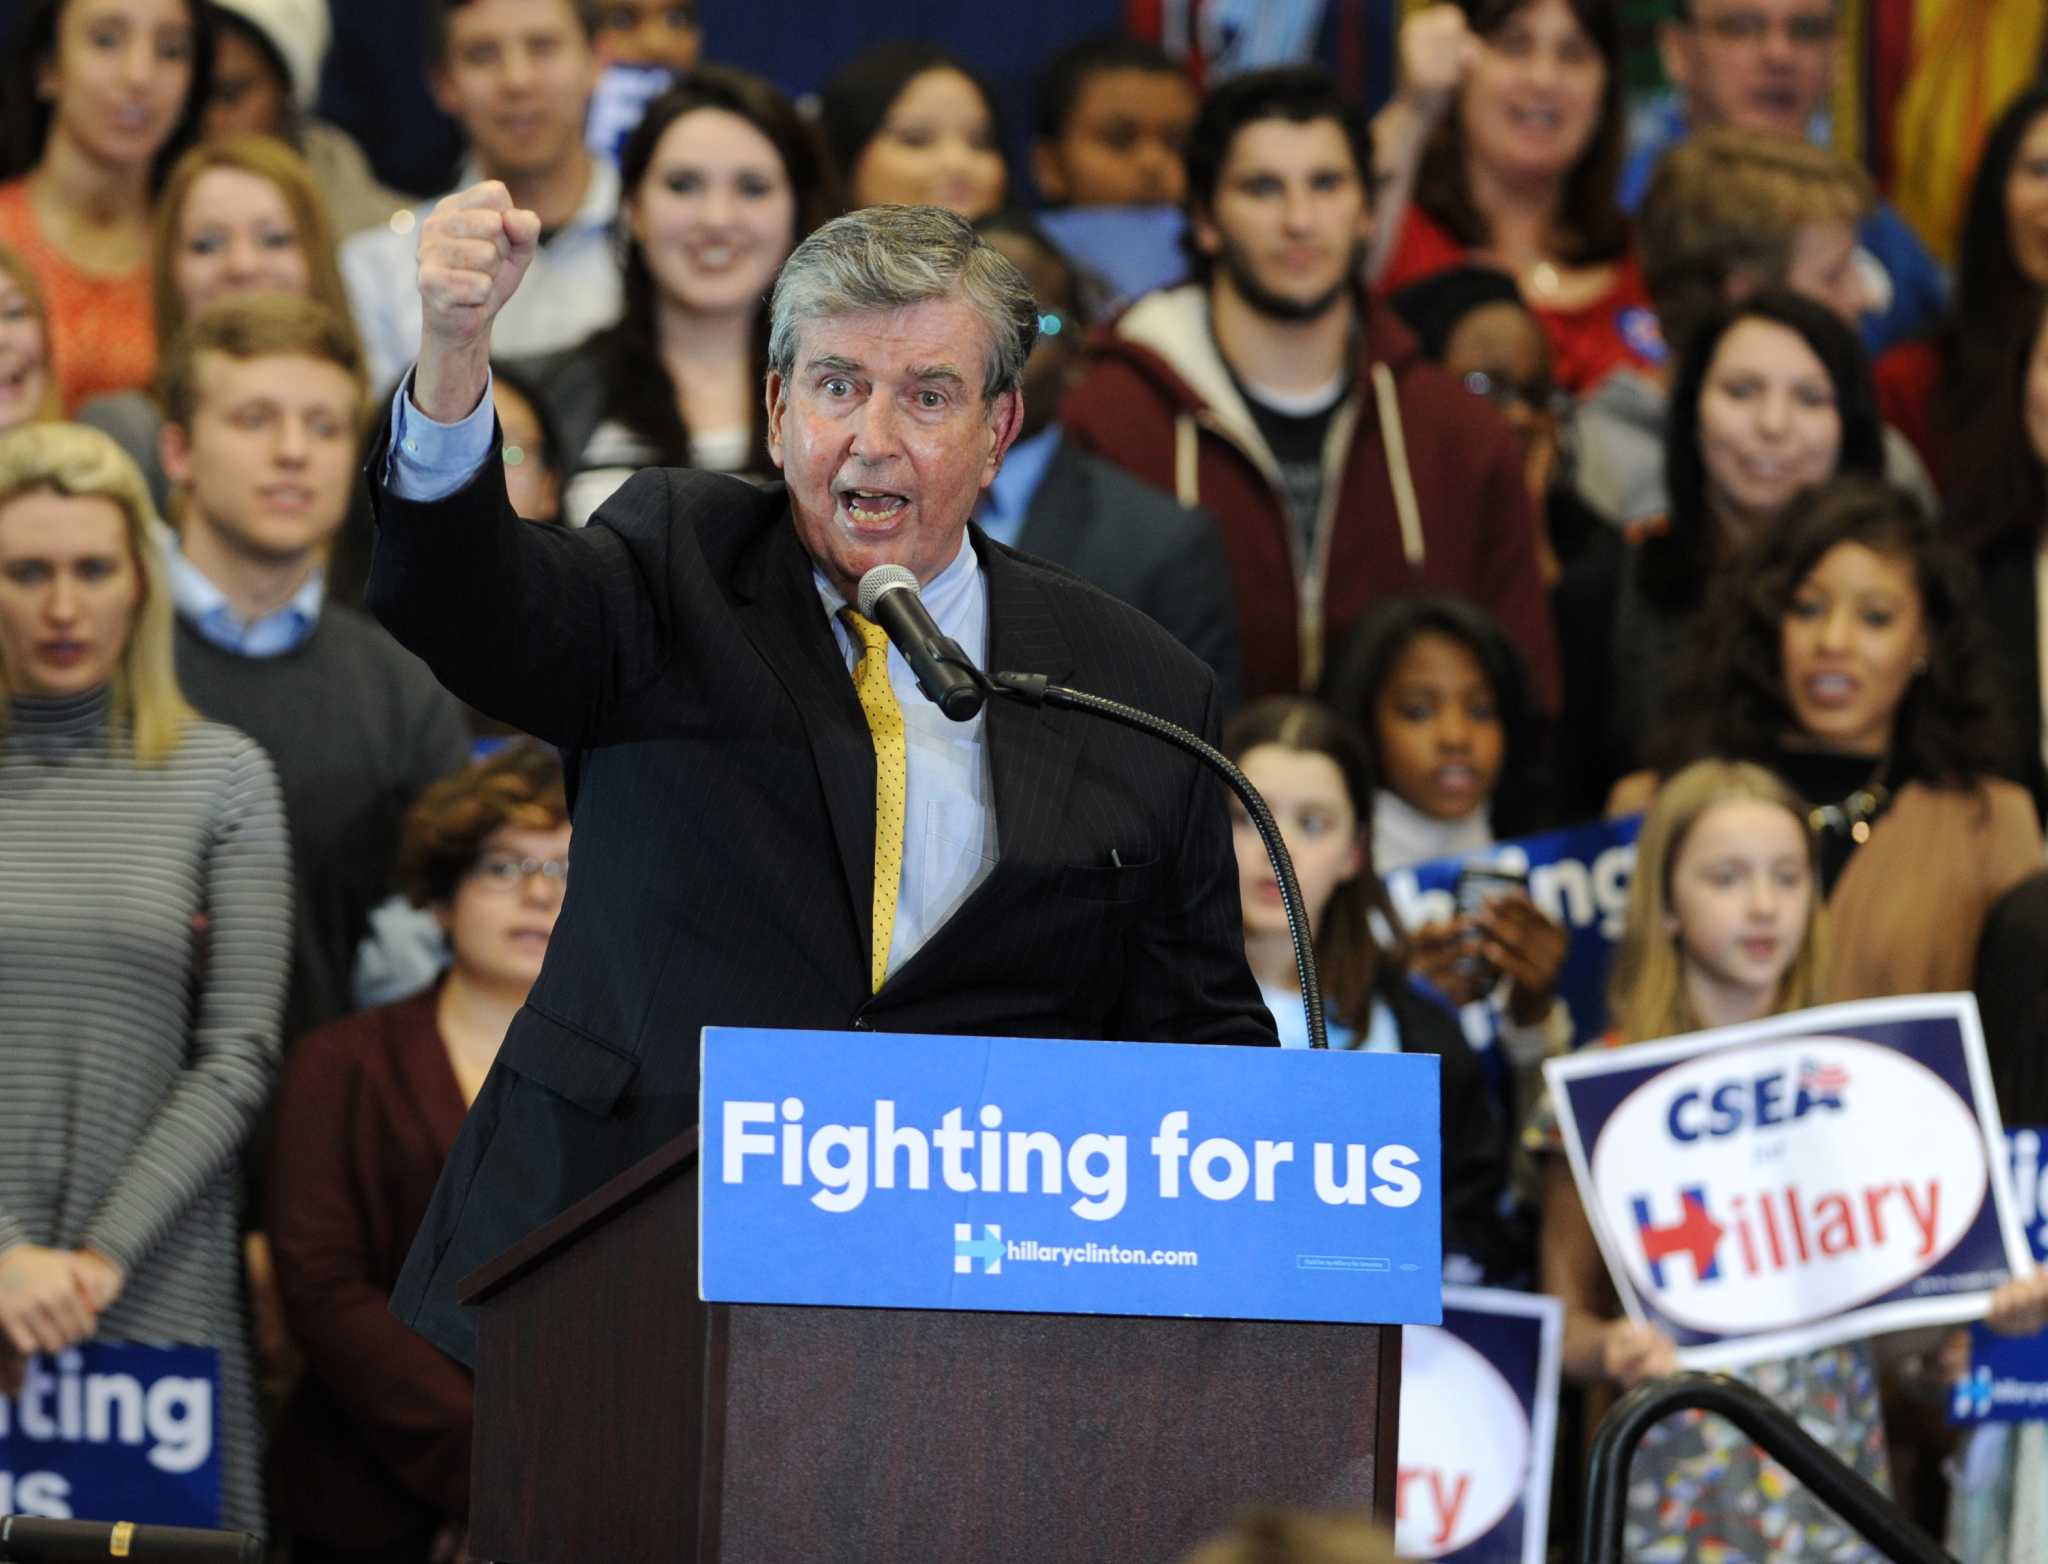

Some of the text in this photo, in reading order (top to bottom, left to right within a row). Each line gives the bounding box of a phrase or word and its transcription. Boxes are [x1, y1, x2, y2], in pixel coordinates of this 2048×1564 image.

[1667, 1058, 1850, 1143] CSEA
[723, 1097, 1422, 1221] Fighting for us
[1007, 1240, 1198, 1266] hillaryclinton.com
[1630, 1176, 1941, 1290] Hillary
[0, 1350, 213, 1473] ting
